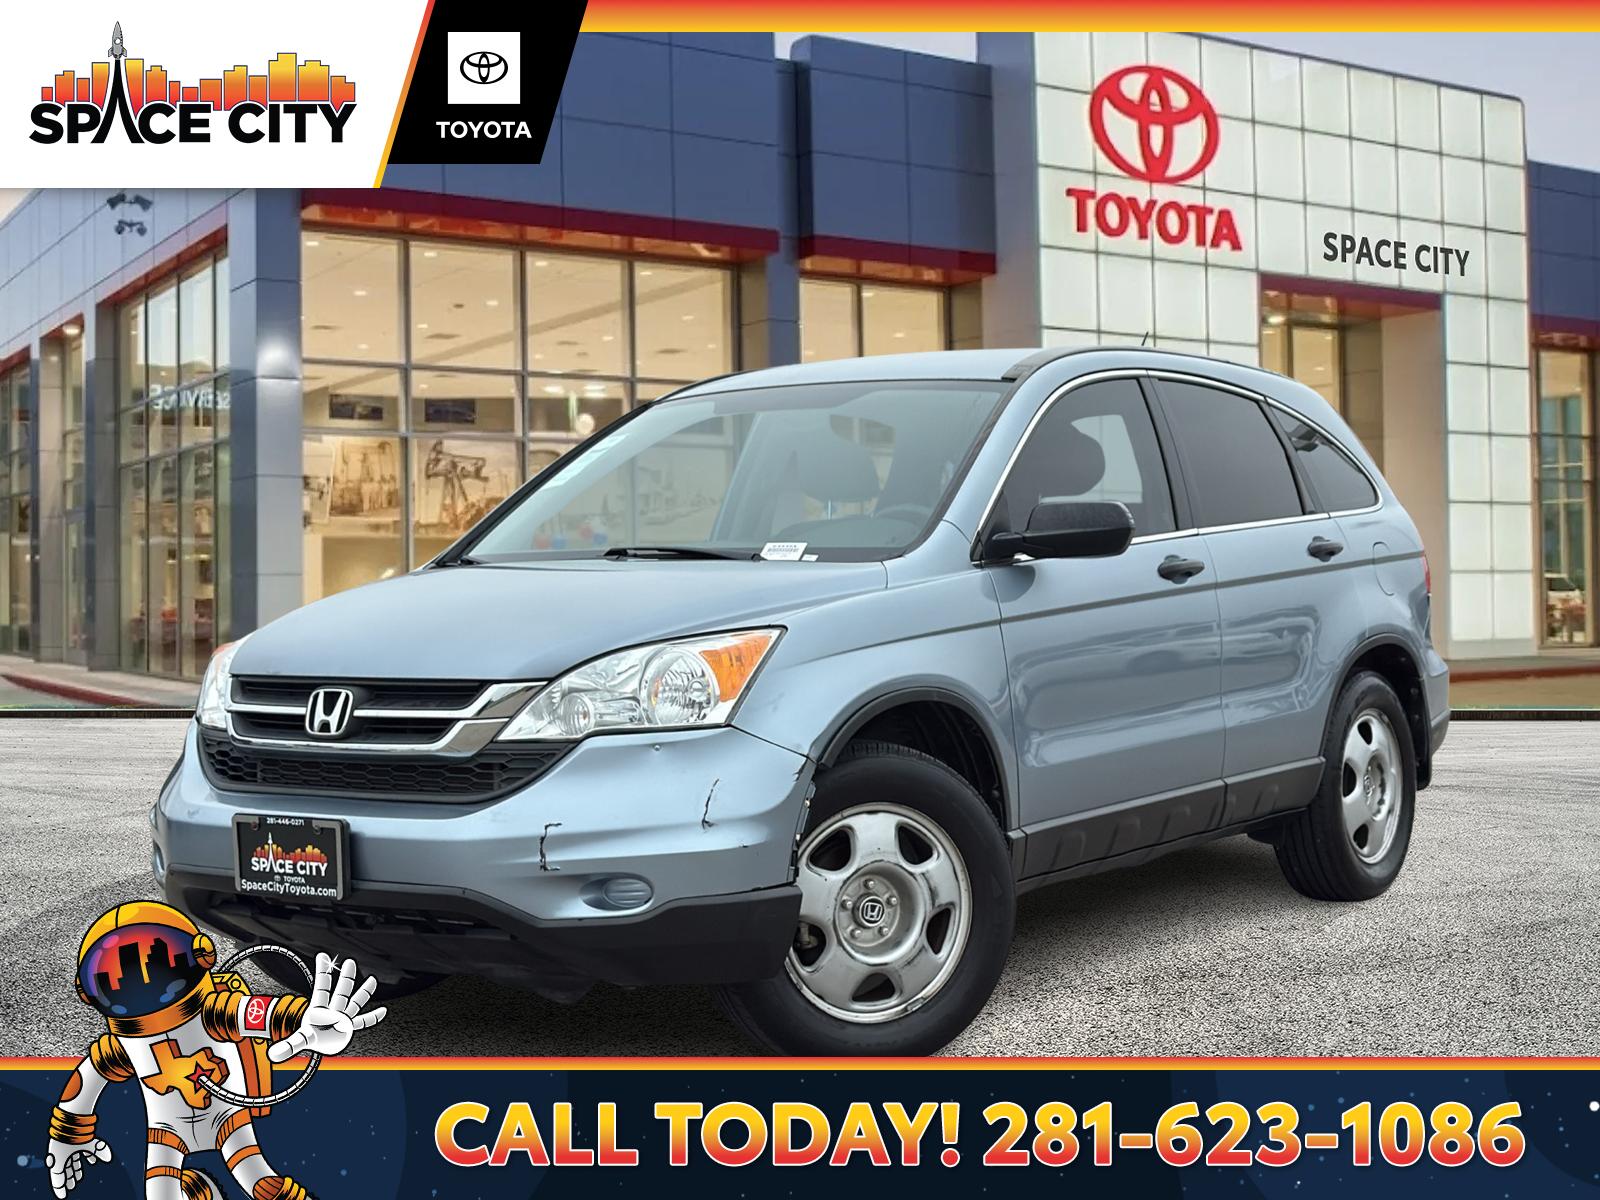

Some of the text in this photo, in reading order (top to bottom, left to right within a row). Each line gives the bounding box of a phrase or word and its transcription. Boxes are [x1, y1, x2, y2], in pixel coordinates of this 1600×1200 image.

[1065, 187, 1242, 252] TOYOTA
[1323, 232, 1470, 276] SPACE CITY
[251, 850, 328, 877] SPACE CITY
[241, 879, 337, 897] SpaceCityToyota.com
[283, 875, 306, 884] TOYOTA
